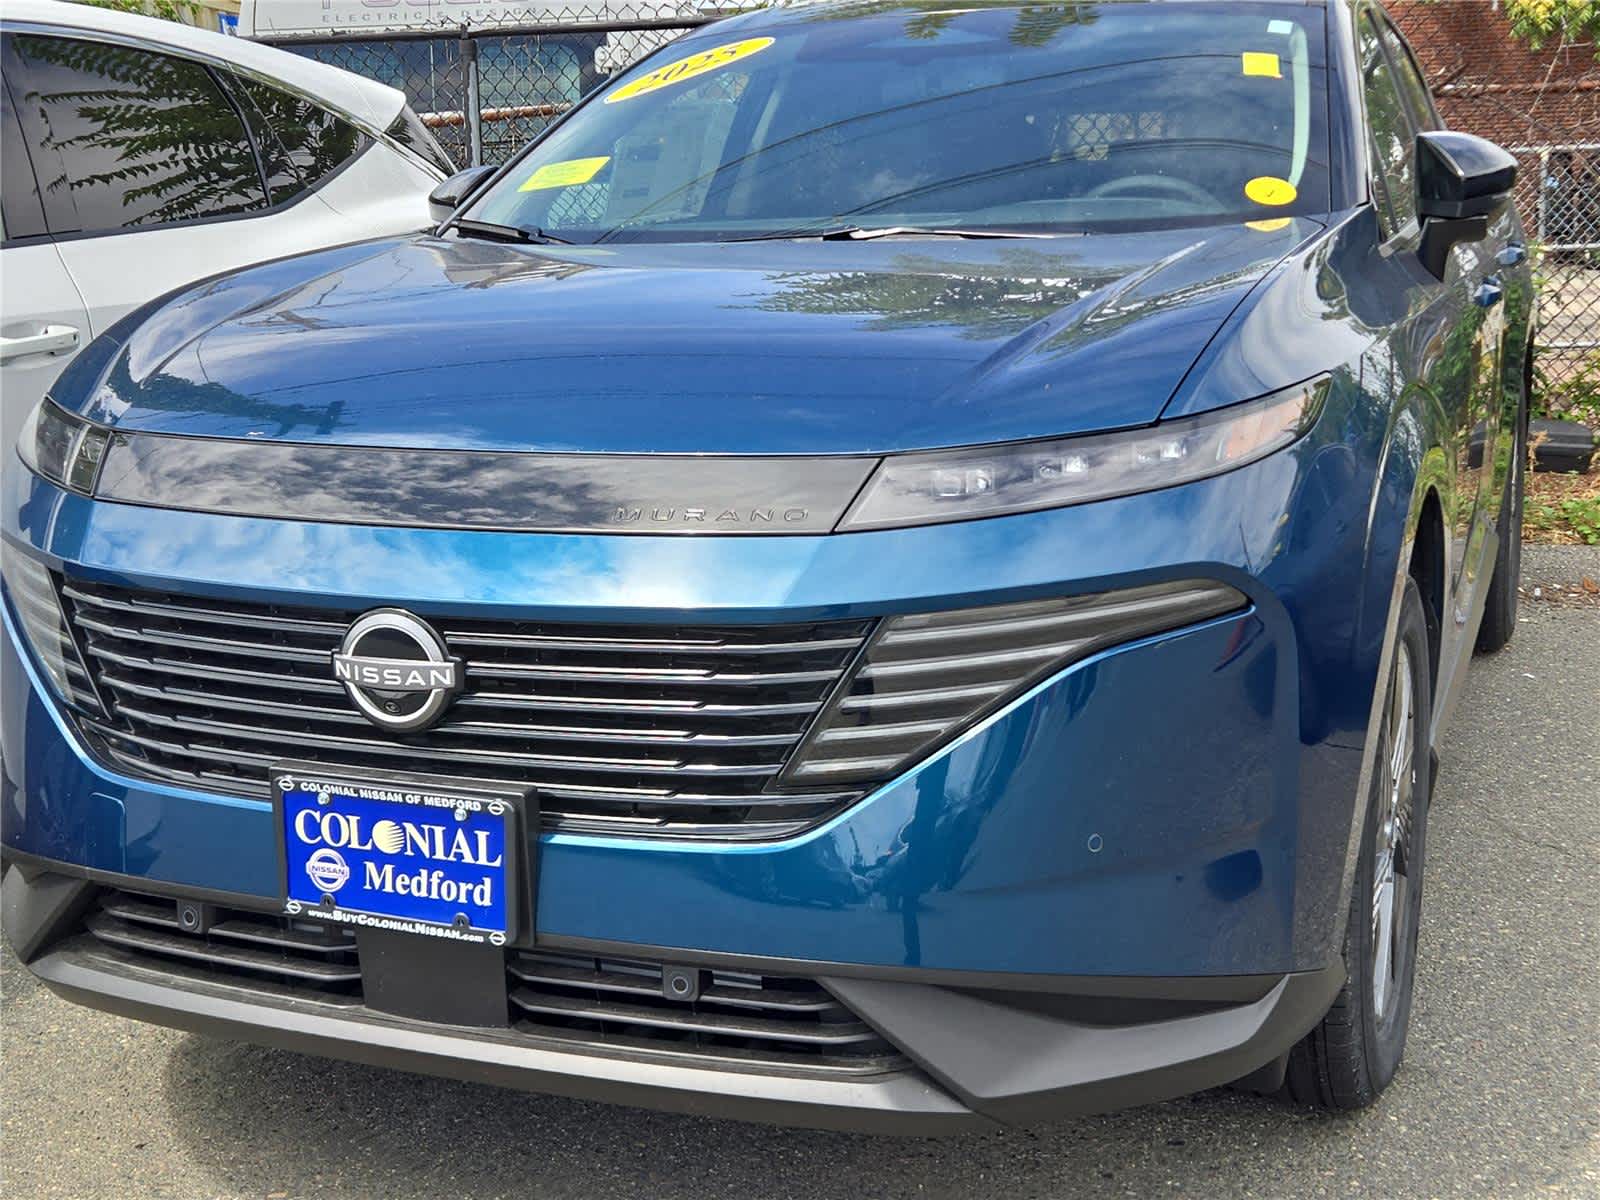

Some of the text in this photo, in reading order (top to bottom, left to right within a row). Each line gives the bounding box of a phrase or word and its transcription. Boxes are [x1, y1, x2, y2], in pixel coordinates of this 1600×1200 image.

[321, 12, 423, 23] ELECTRIC
[461, 7, 538, 18] DESIGN
[635, 43, 743, 93] 2025
[611, 507, 808, 521] MURANO
[335, 660, 451, 686] NISSAN
[300, 782, 481, 811] COLONIAL NISSAN OF MEDFORD
[295, 809, 502, 867] COLONIAL
[311, 865, 346, 875] NISSAN
[363, 861, 493, 906] Medford
